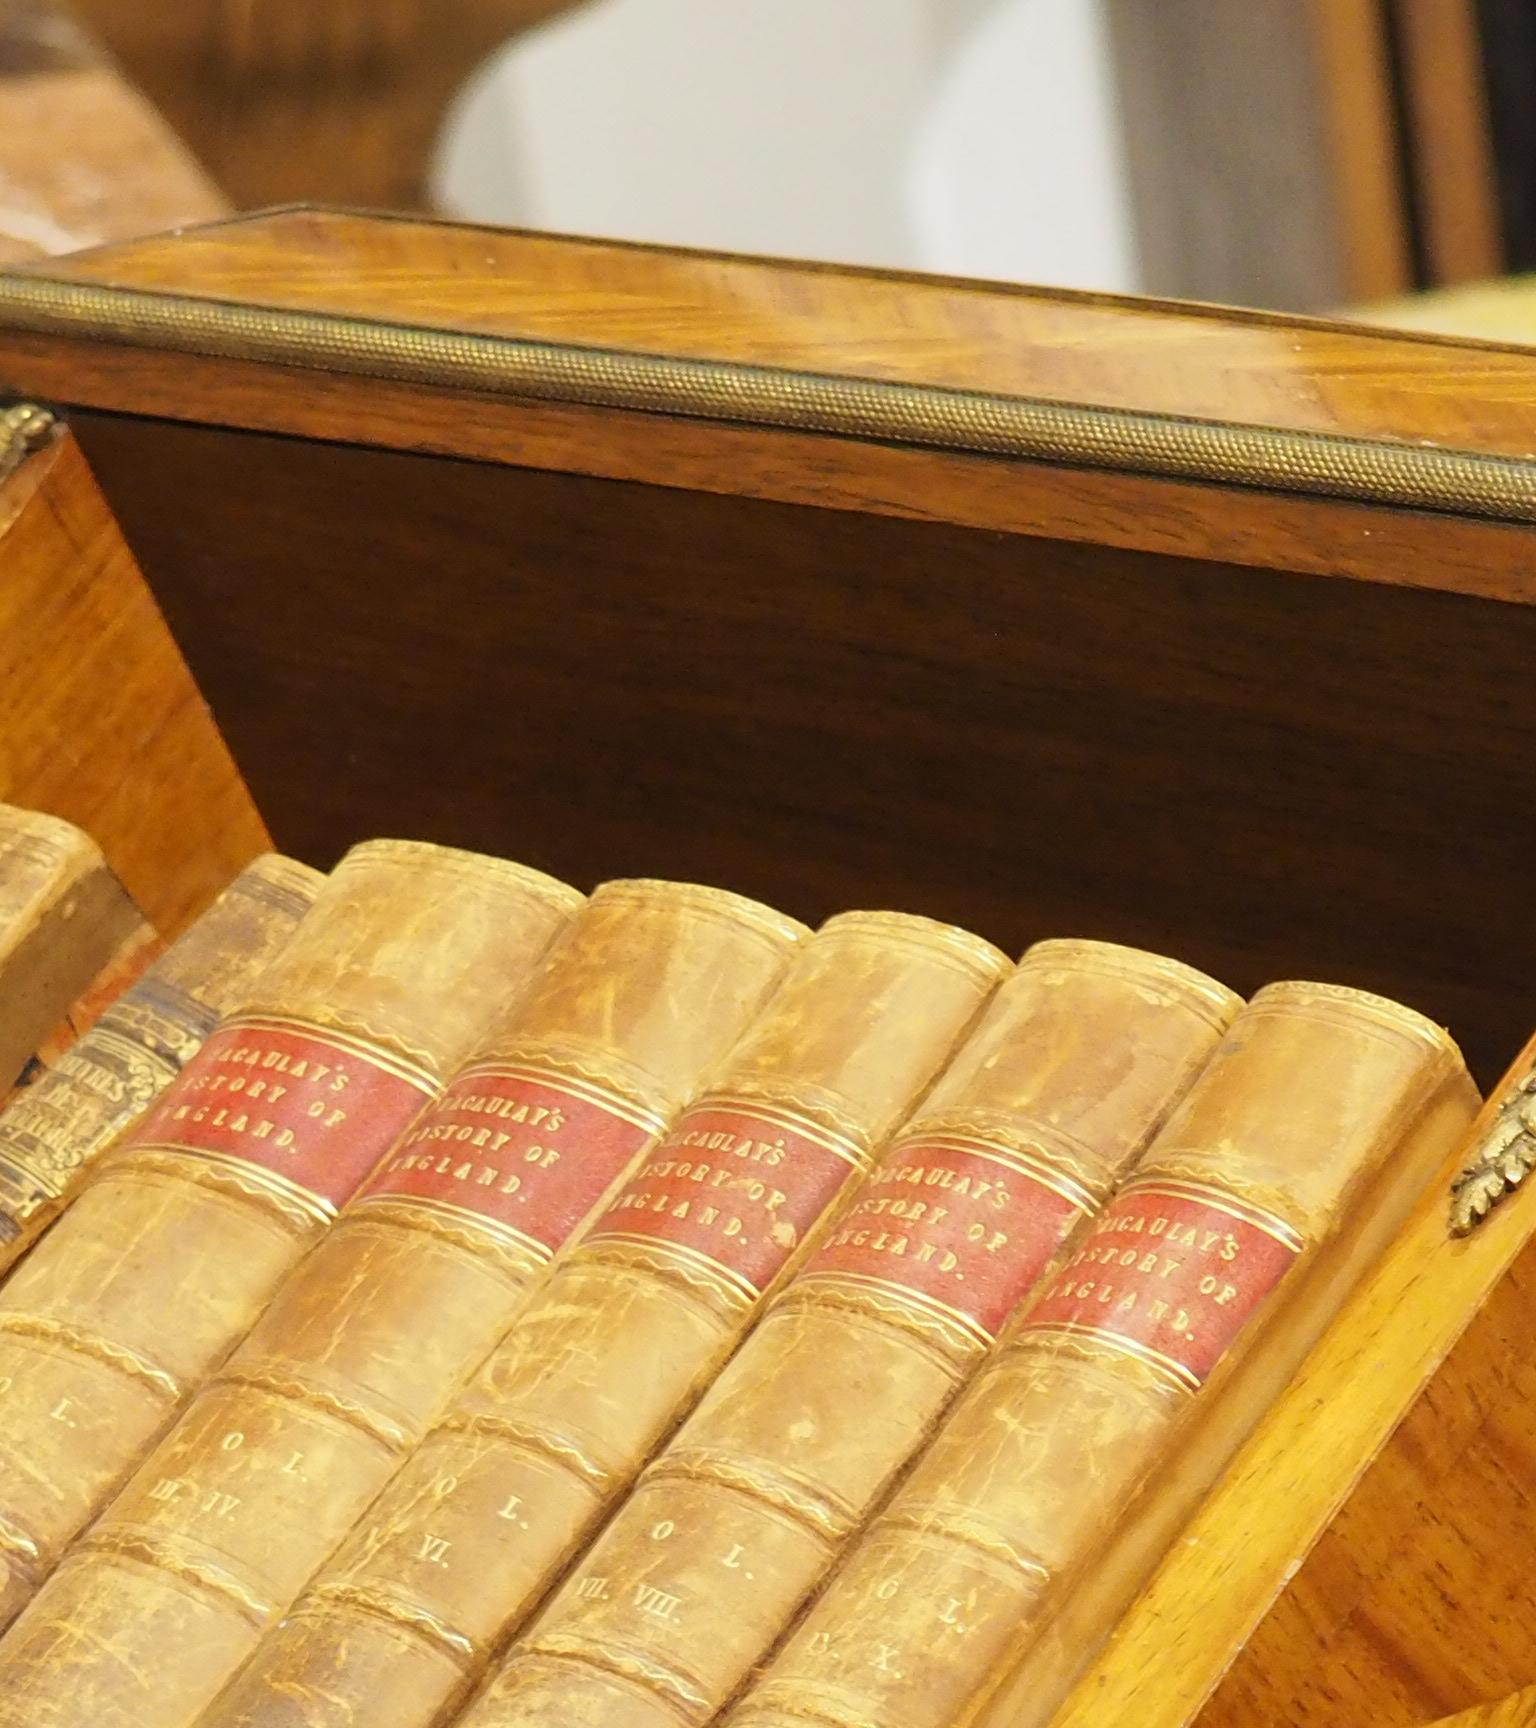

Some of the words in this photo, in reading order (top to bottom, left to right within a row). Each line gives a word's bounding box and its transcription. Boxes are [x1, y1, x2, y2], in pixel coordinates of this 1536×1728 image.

[217, 1047, 349, 1092] ACAULAY'S
[181, 1075, 287, 1104] ISTORY
[308, 1101, 346, 1127] OF
[162, 1104, 296, 1154] NGLAND.
[524, 1145, 561, 1169] OF
[640, 1161, 732, 1187] ISTORY
[747, 1183, 786, 1211] OF
[848, 1198, 949, 1225] ISTORY
[967, 1223, 1008, 1253] OF
[1199, 1275, 1237, 1305] OF
[414, 1532, 453, 1569] VI.
[634, 1583, 682, 1624] VIII.
